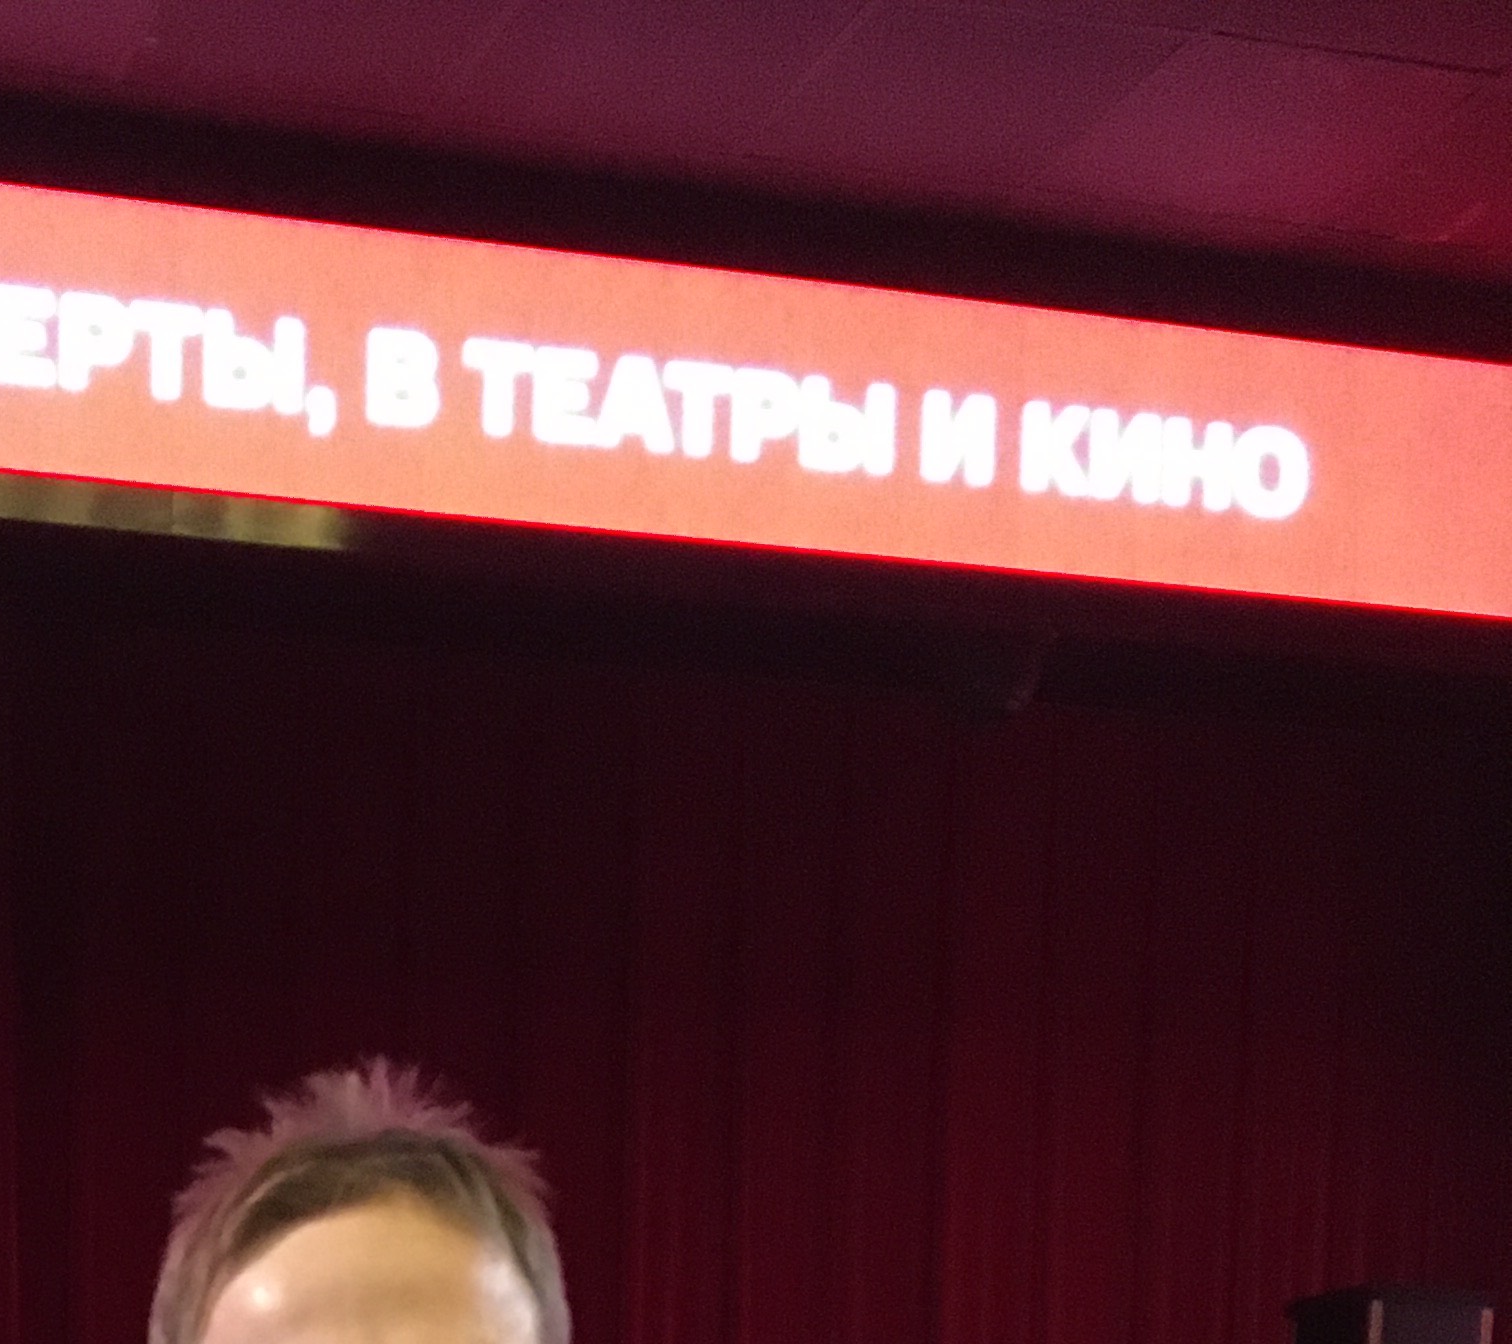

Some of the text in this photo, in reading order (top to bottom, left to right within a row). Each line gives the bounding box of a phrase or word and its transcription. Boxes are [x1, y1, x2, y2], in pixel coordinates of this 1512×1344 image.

[364, 325, 442, 430] В
[459, 334, 898, 478] ТЕАТРЫ
[918, 387, 1000, 488] И
[1019, 398, 1313, 522] КИНО
